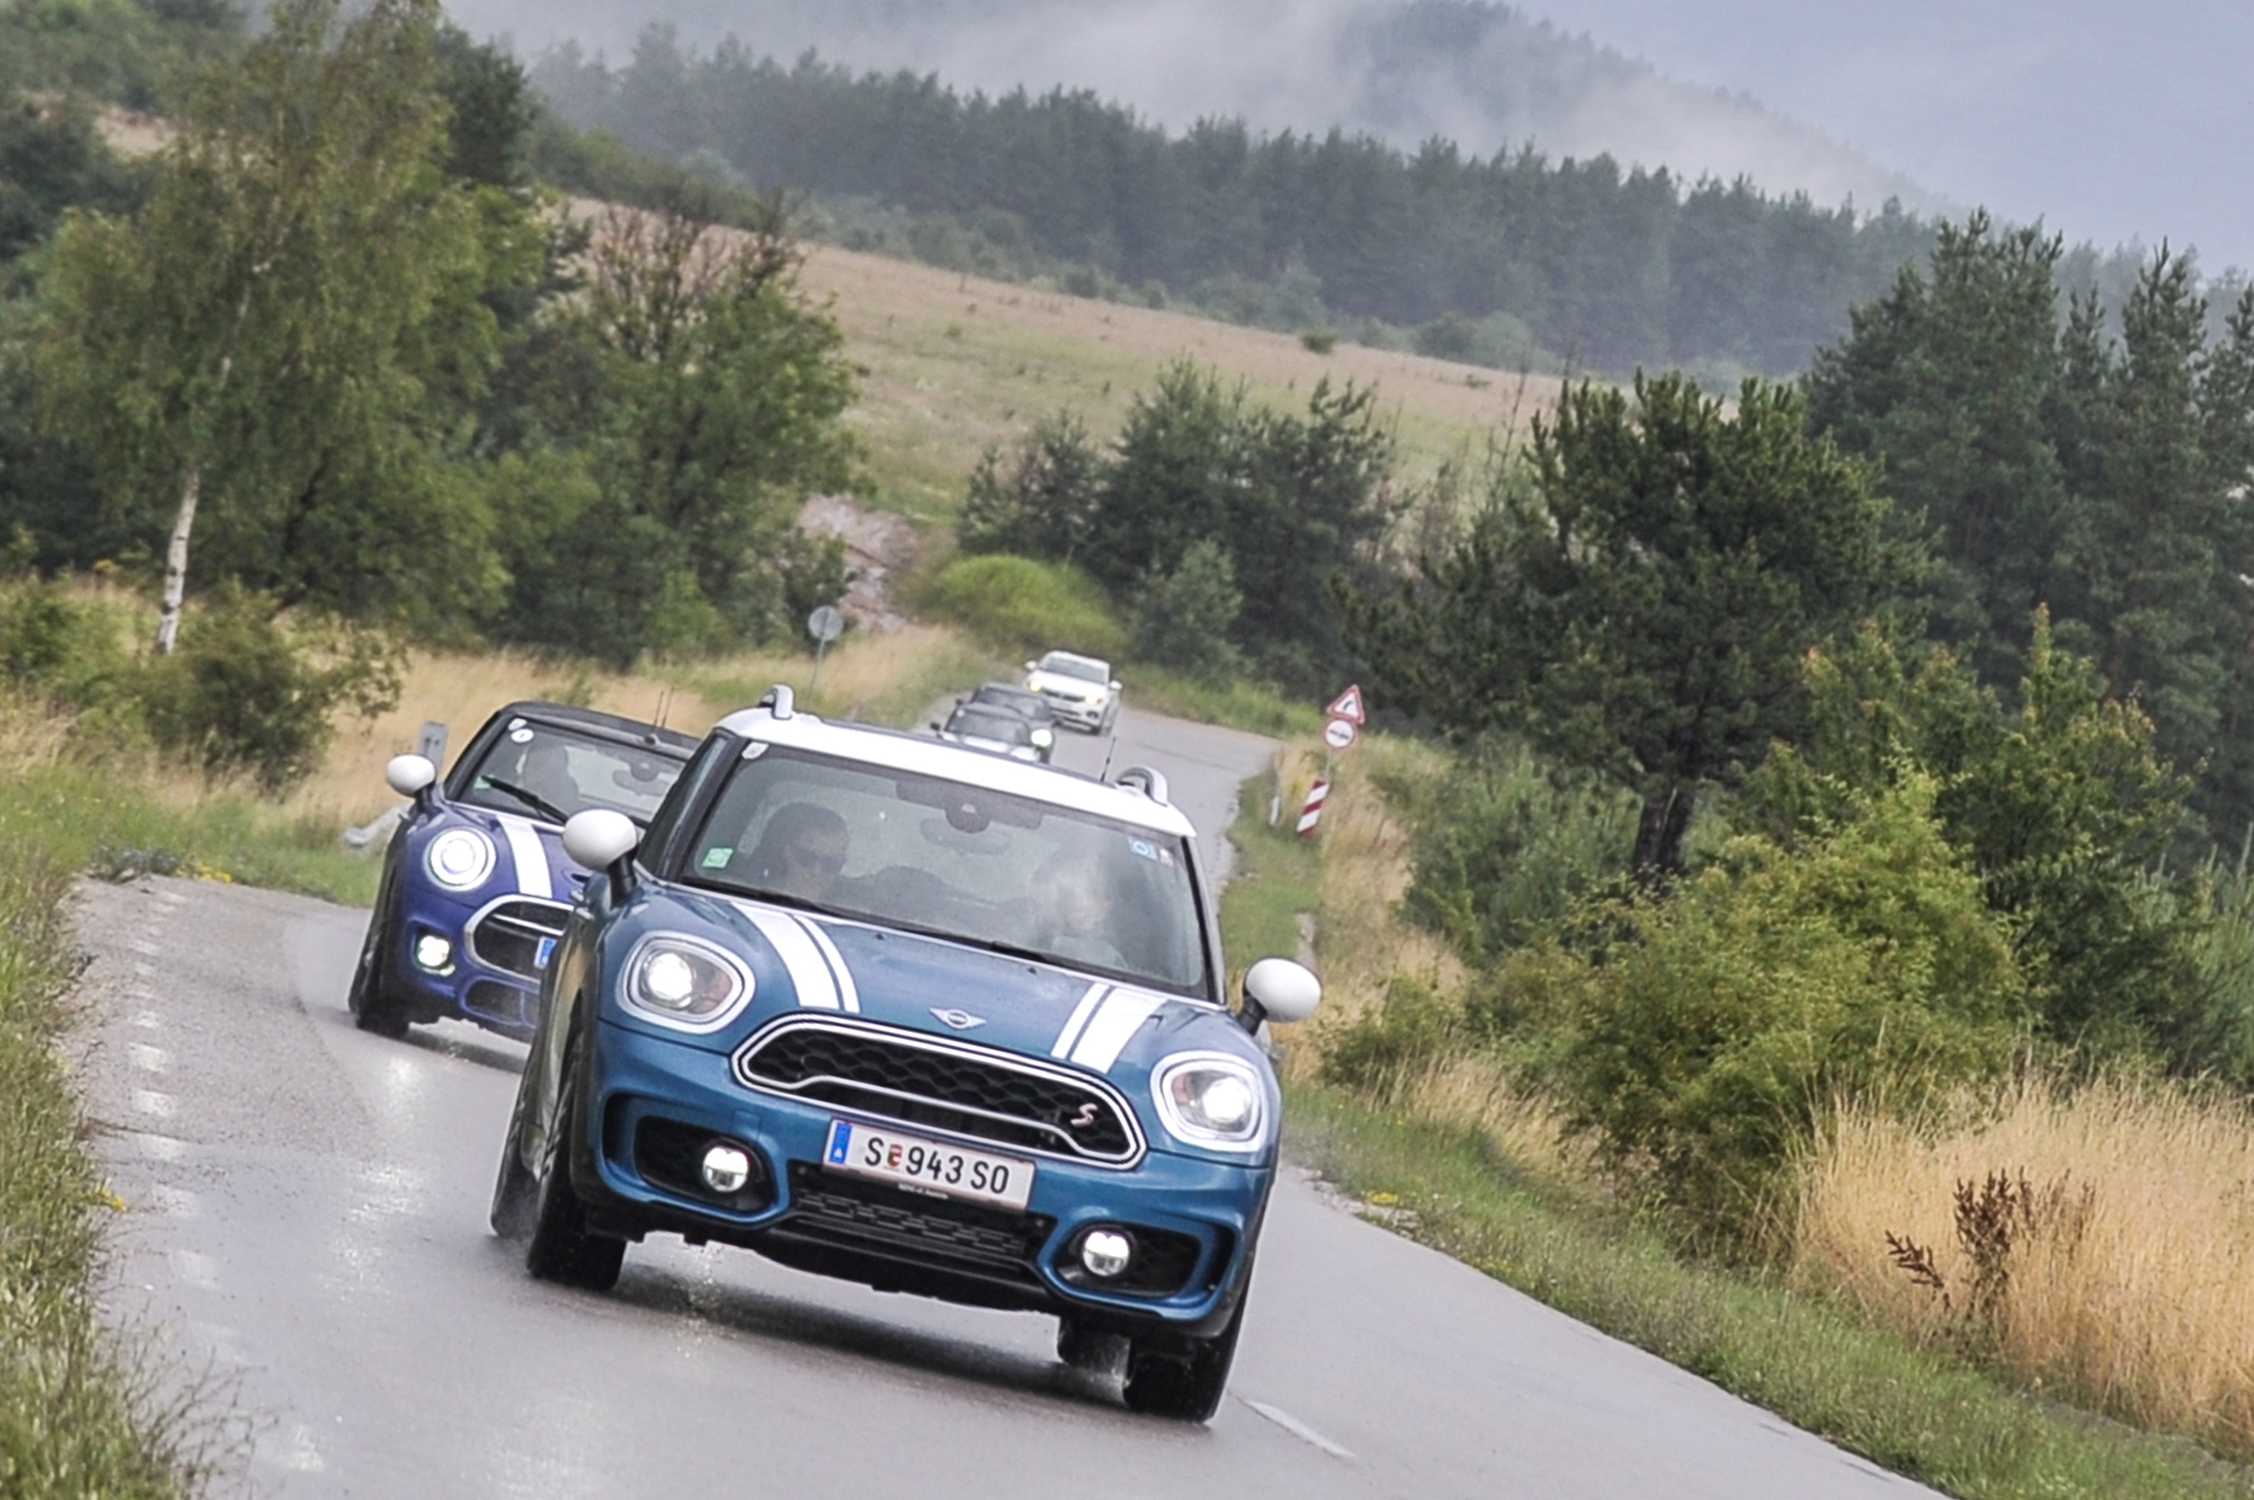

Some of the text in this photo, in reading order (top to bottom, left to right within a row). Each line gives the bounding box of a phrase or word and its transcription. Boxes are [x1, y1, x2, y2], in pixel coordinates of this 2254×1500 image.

[1070, 1103, 1098, 1127] S
[864, 1136, 884, 1166] S
[906, 1146, 964, 1184] 943
